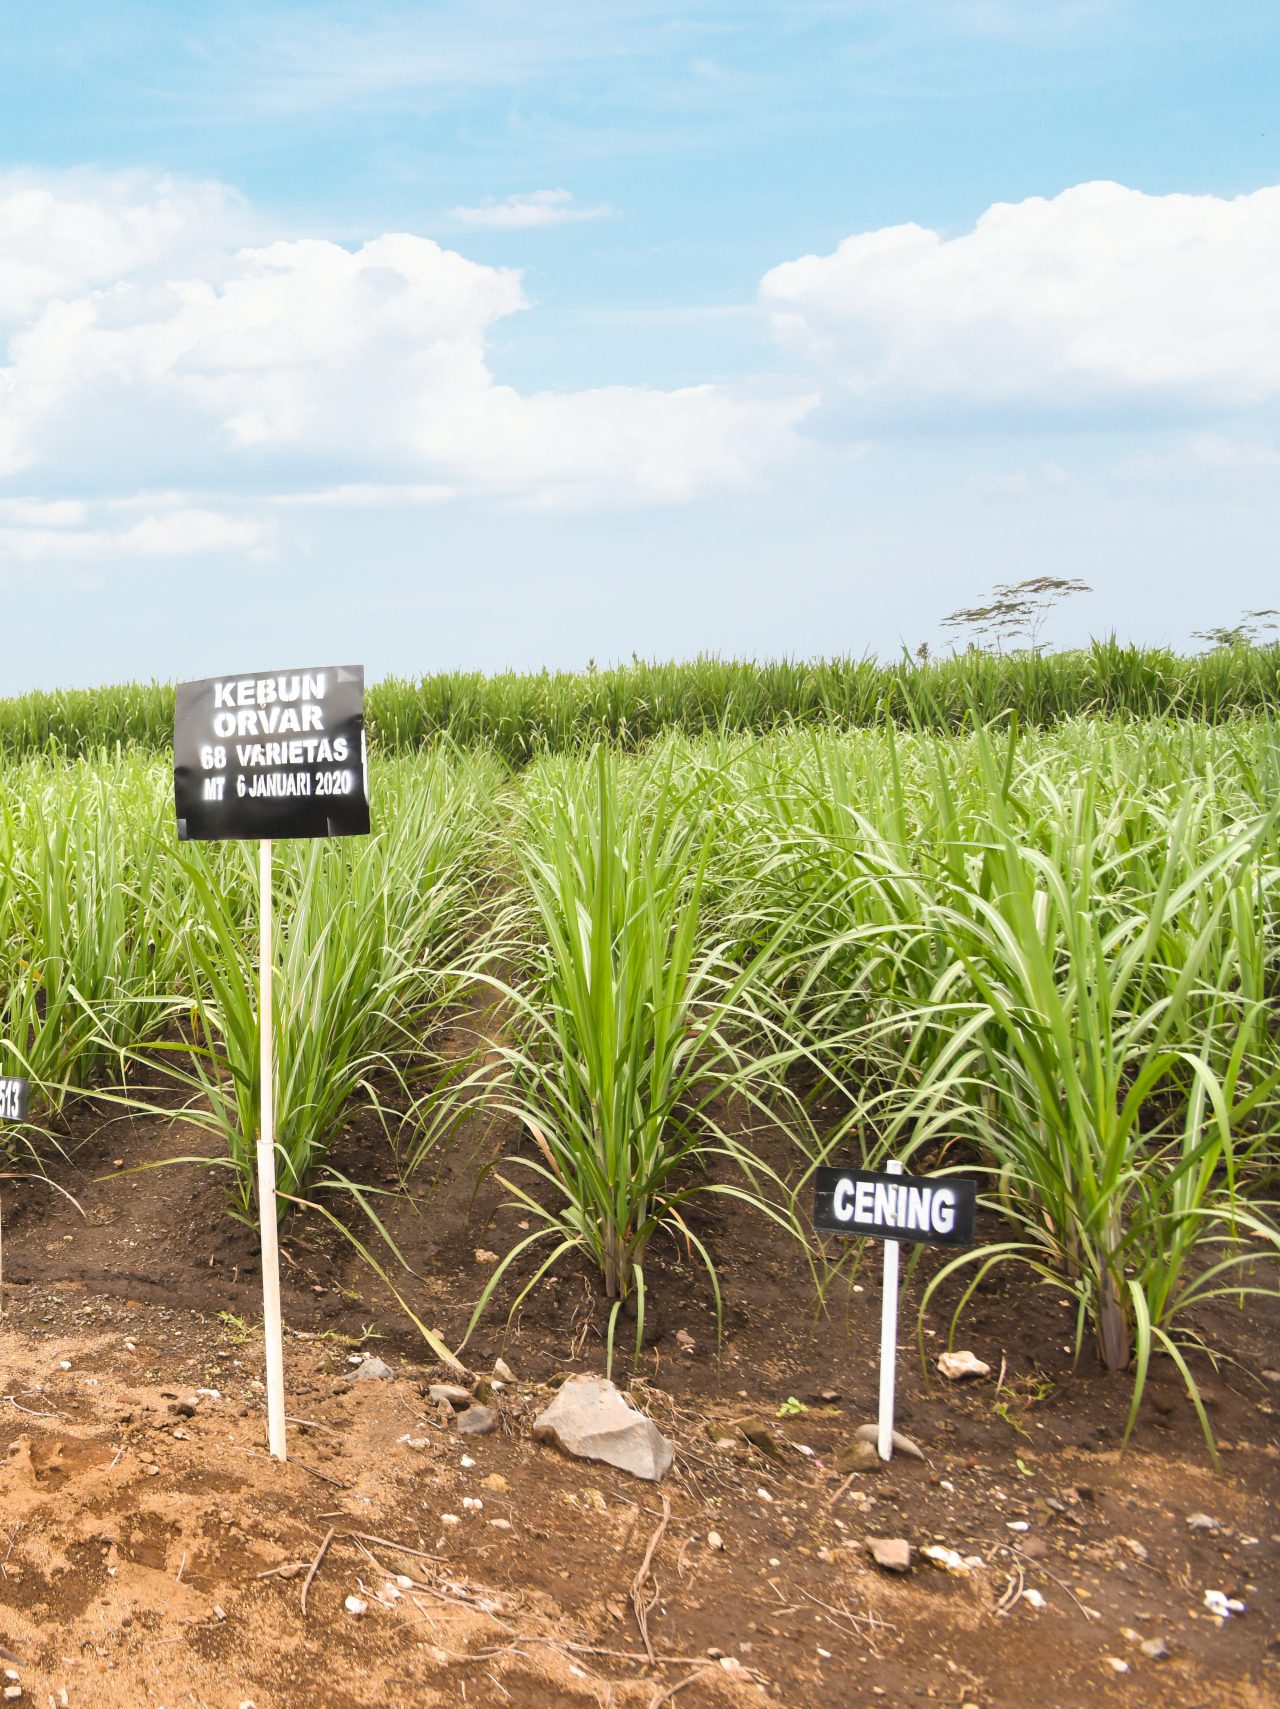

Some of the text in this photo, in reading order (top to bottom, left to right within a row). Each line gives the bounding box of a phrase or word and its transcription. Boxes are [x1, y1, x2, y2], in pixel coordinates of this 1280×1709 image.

[213, 673, 325, 708] KEBUN
[213, 704, 324, 738] ORVAR
[200, 737, 349, 769] 68 VARIETAS
[203, 770, 352, 800] MT 6 JANUARI 2020
[833, 1178, 956, 1234] CENING
